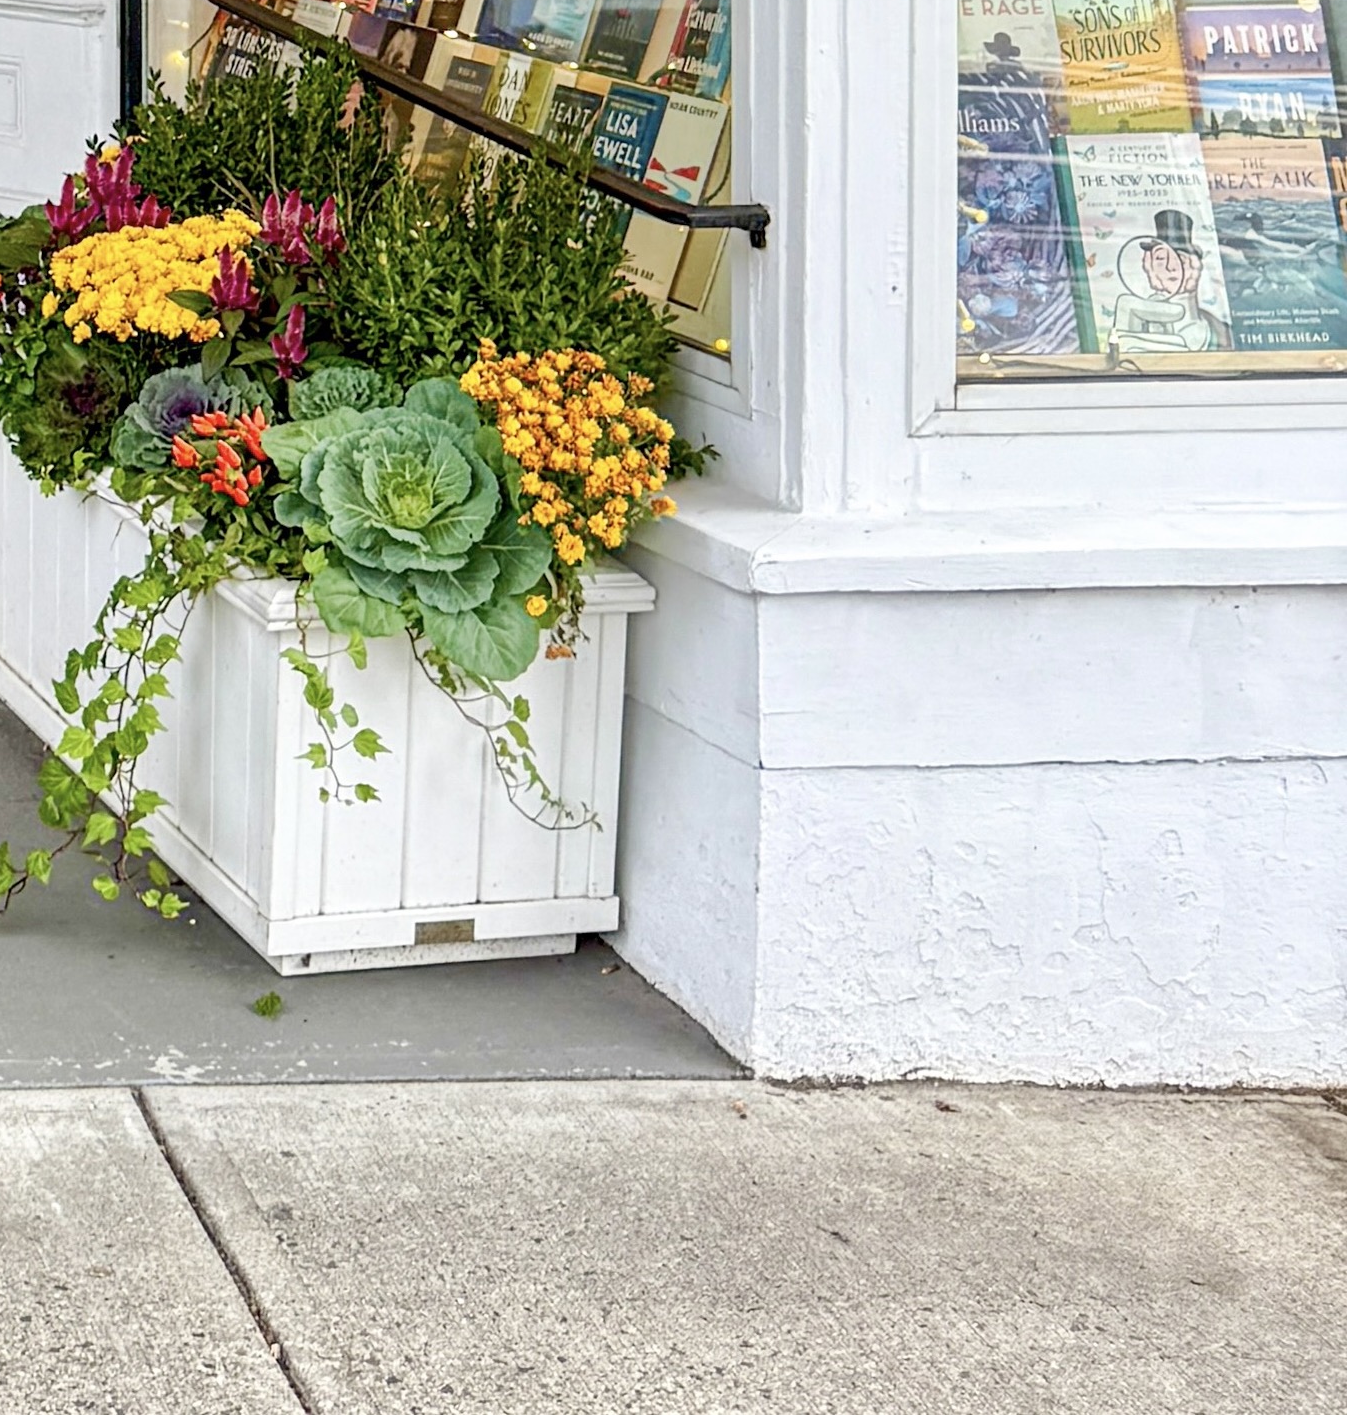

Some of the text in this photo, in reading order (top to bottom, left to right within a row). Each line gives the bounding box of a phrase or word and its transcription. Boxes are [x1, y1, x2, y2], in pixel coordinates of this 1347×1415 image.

[1072, 5, 1139, 35] SONS OF
[1059, 28, 1162, 67] SURVIVORS
[1203, 21, 1319, 56] PATRICK
[498, 63, 529, 94] DAN
[1237, 91, 1309, 124] RYAN
[605, 109, 639, 140] LISA
[1108, 152, 1170, 164] FICTION
[1240, 157, 1267, 169] THE
[1078, 173, 1203, 188] THE NEW YORKER
[1273, 170, 1317, 189] AUK
[1239, 331, 1330, 344] TIM BIRKHEAD
